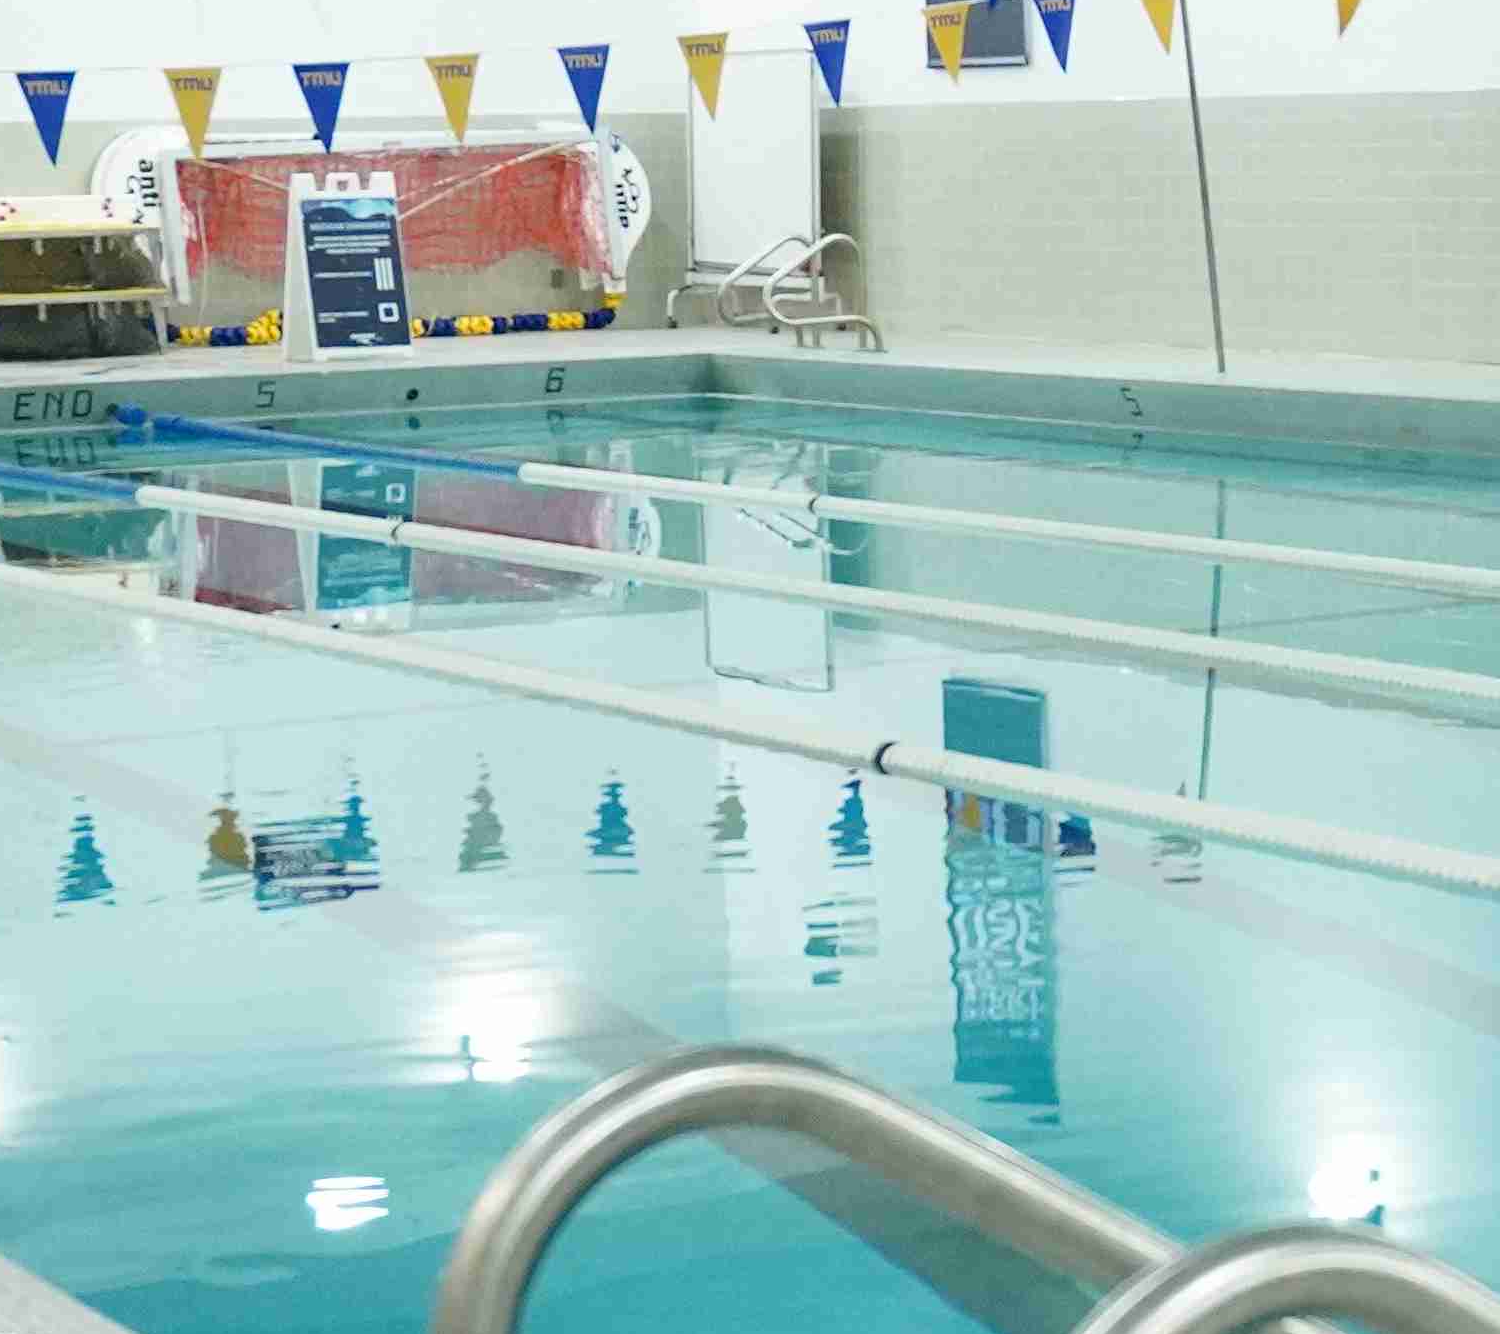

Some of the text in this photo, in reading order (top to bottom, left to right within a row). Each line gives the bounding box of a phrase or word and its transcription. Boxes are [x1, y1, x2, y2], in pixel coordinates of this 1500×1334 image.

[255, 379, 277, 408] 5
[545, 367, 566, 394] 6
[13, 389, 94, 421] END
[1119, 387, 1143, 418] 5
